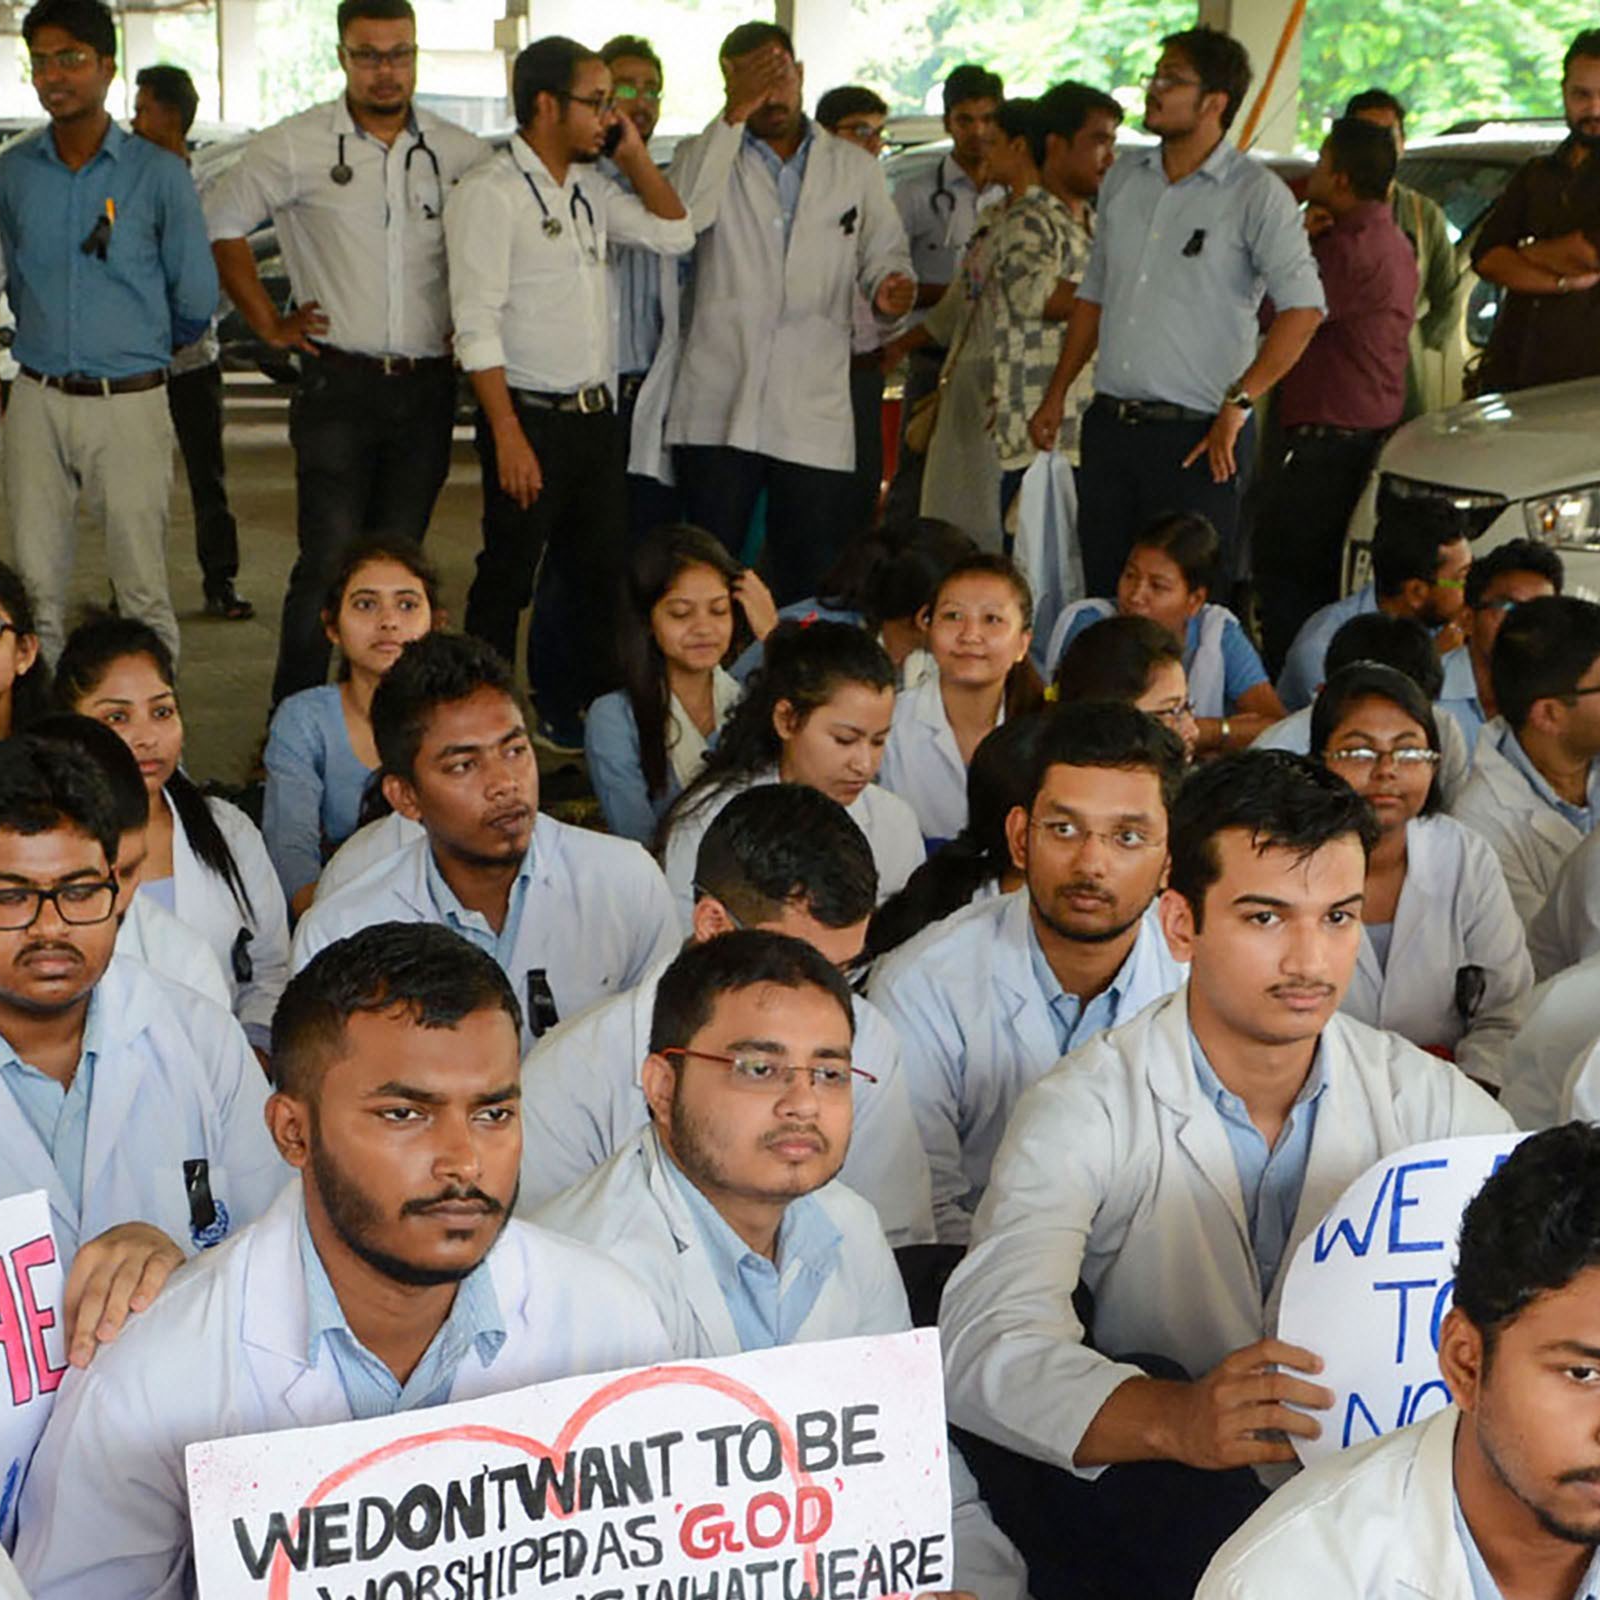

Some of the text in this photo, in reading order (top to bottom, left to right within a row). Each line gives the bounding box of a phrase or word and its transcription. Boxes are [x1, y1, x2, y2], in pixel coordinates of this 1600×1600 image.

[1313, 1158, 1449, 1264] WE
[696, 1418, 782, 1484] TO
[798, 1403, 885, 1473] BE
